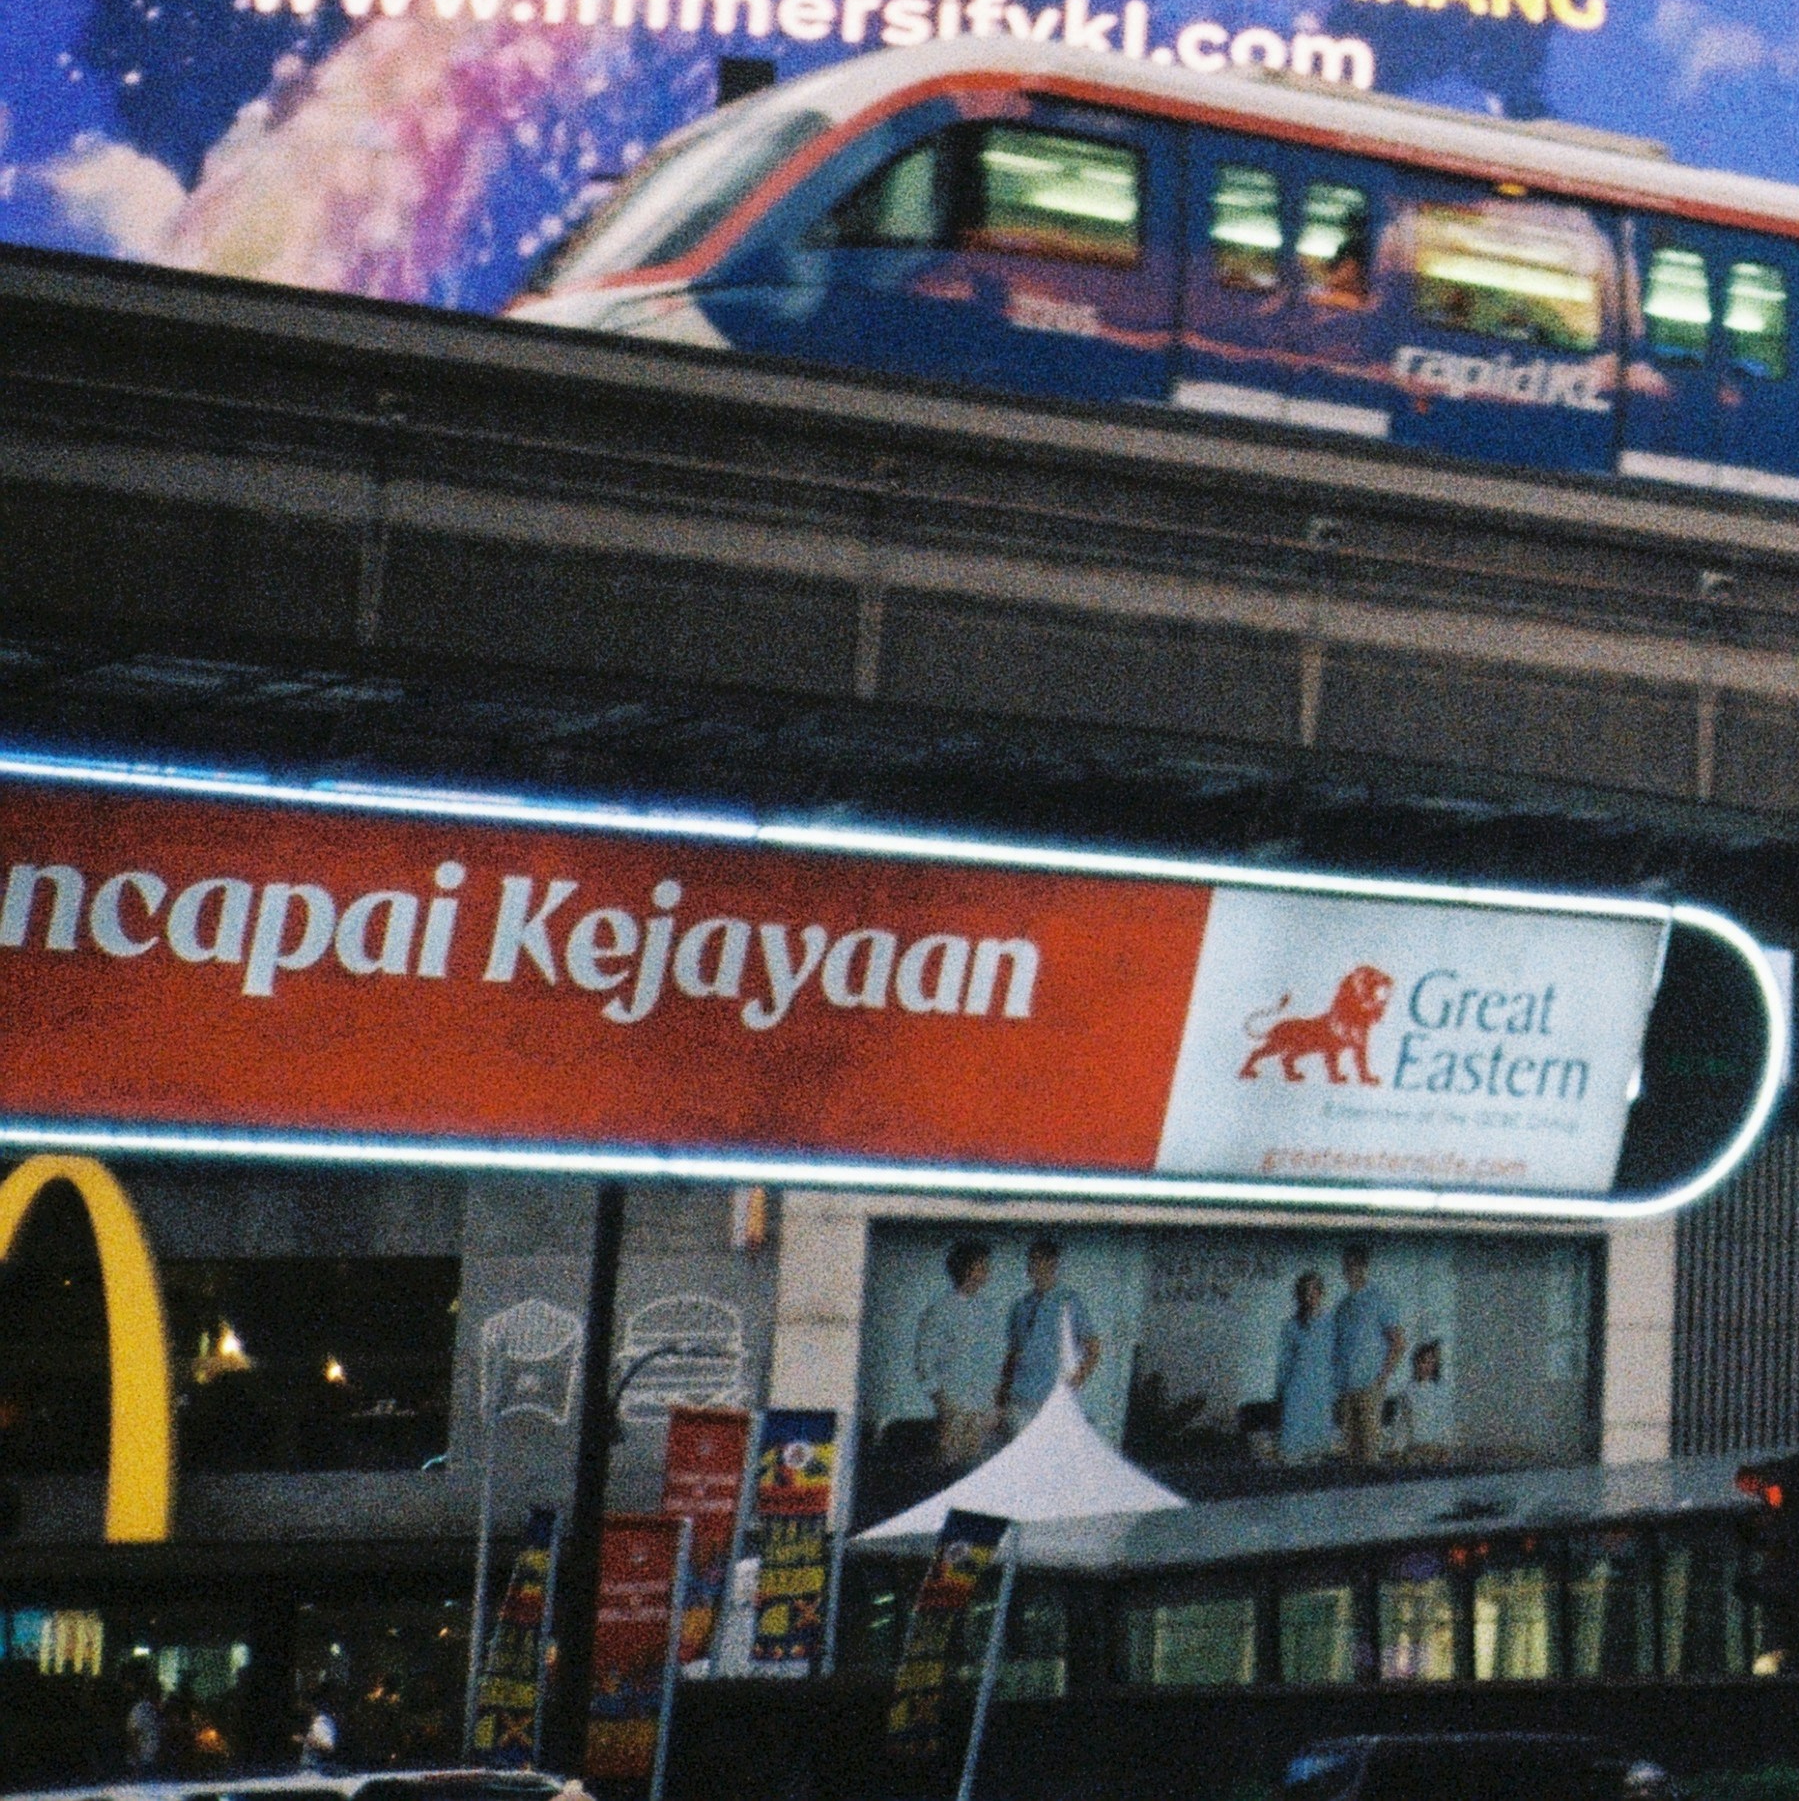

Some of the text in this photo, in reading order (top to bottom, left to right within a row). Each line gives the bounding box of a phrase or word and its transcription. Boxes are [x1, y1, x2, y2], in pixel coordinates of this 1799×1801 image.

[0, 860, 1041, 1030] ncapai Kejayaan
[1407, 968, 1556, 1036] Great
[1393, 1031, 1591, 1100] Eastern
